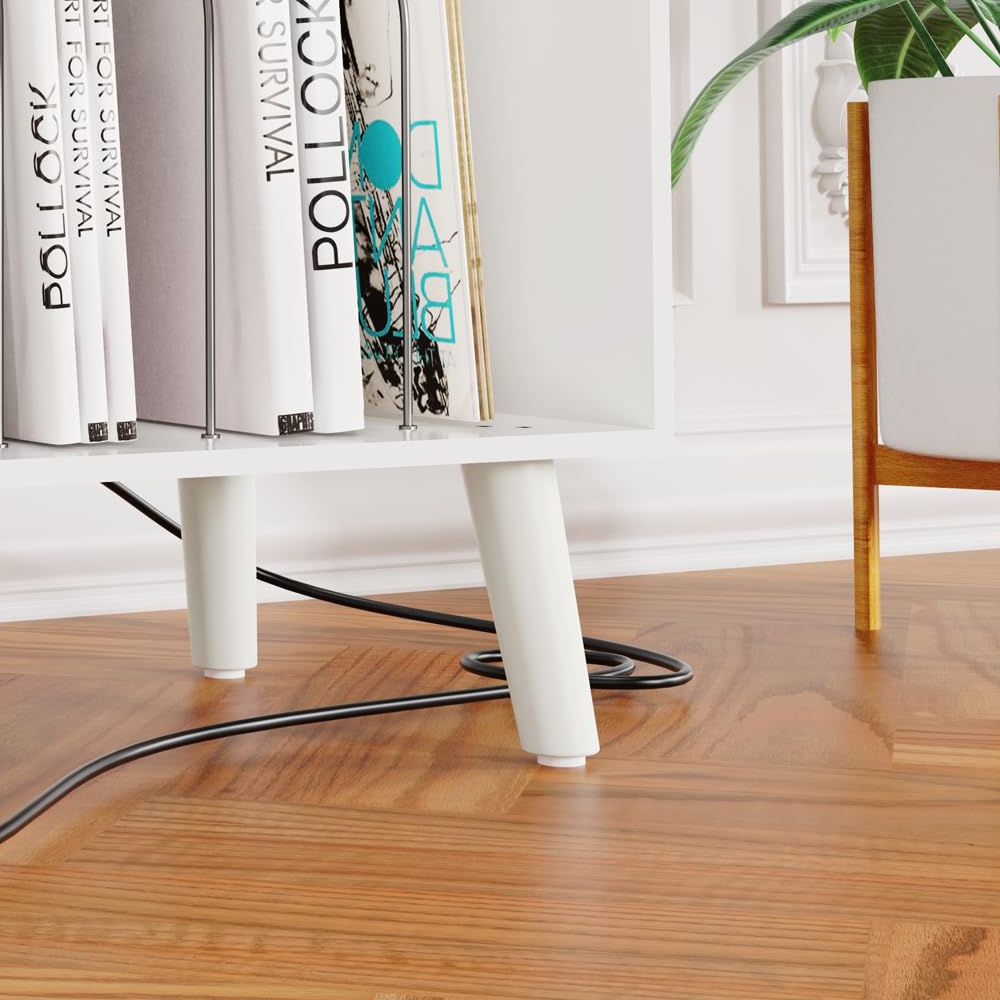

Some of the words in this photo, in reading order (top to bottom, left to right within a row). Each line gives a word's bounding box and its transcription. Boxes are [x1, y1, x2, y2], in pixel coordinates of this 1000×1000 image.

[66, 40, 85, 98] FOR
[95, 41, 113, 98] FOR
[257, 19, 295, 183] SURVIVAL
[28, 81, 71, 310] POLLOCK
[70, 108, 94, 238] SURVIVAL
[99, 108, 123, 238] SURVIVAL
